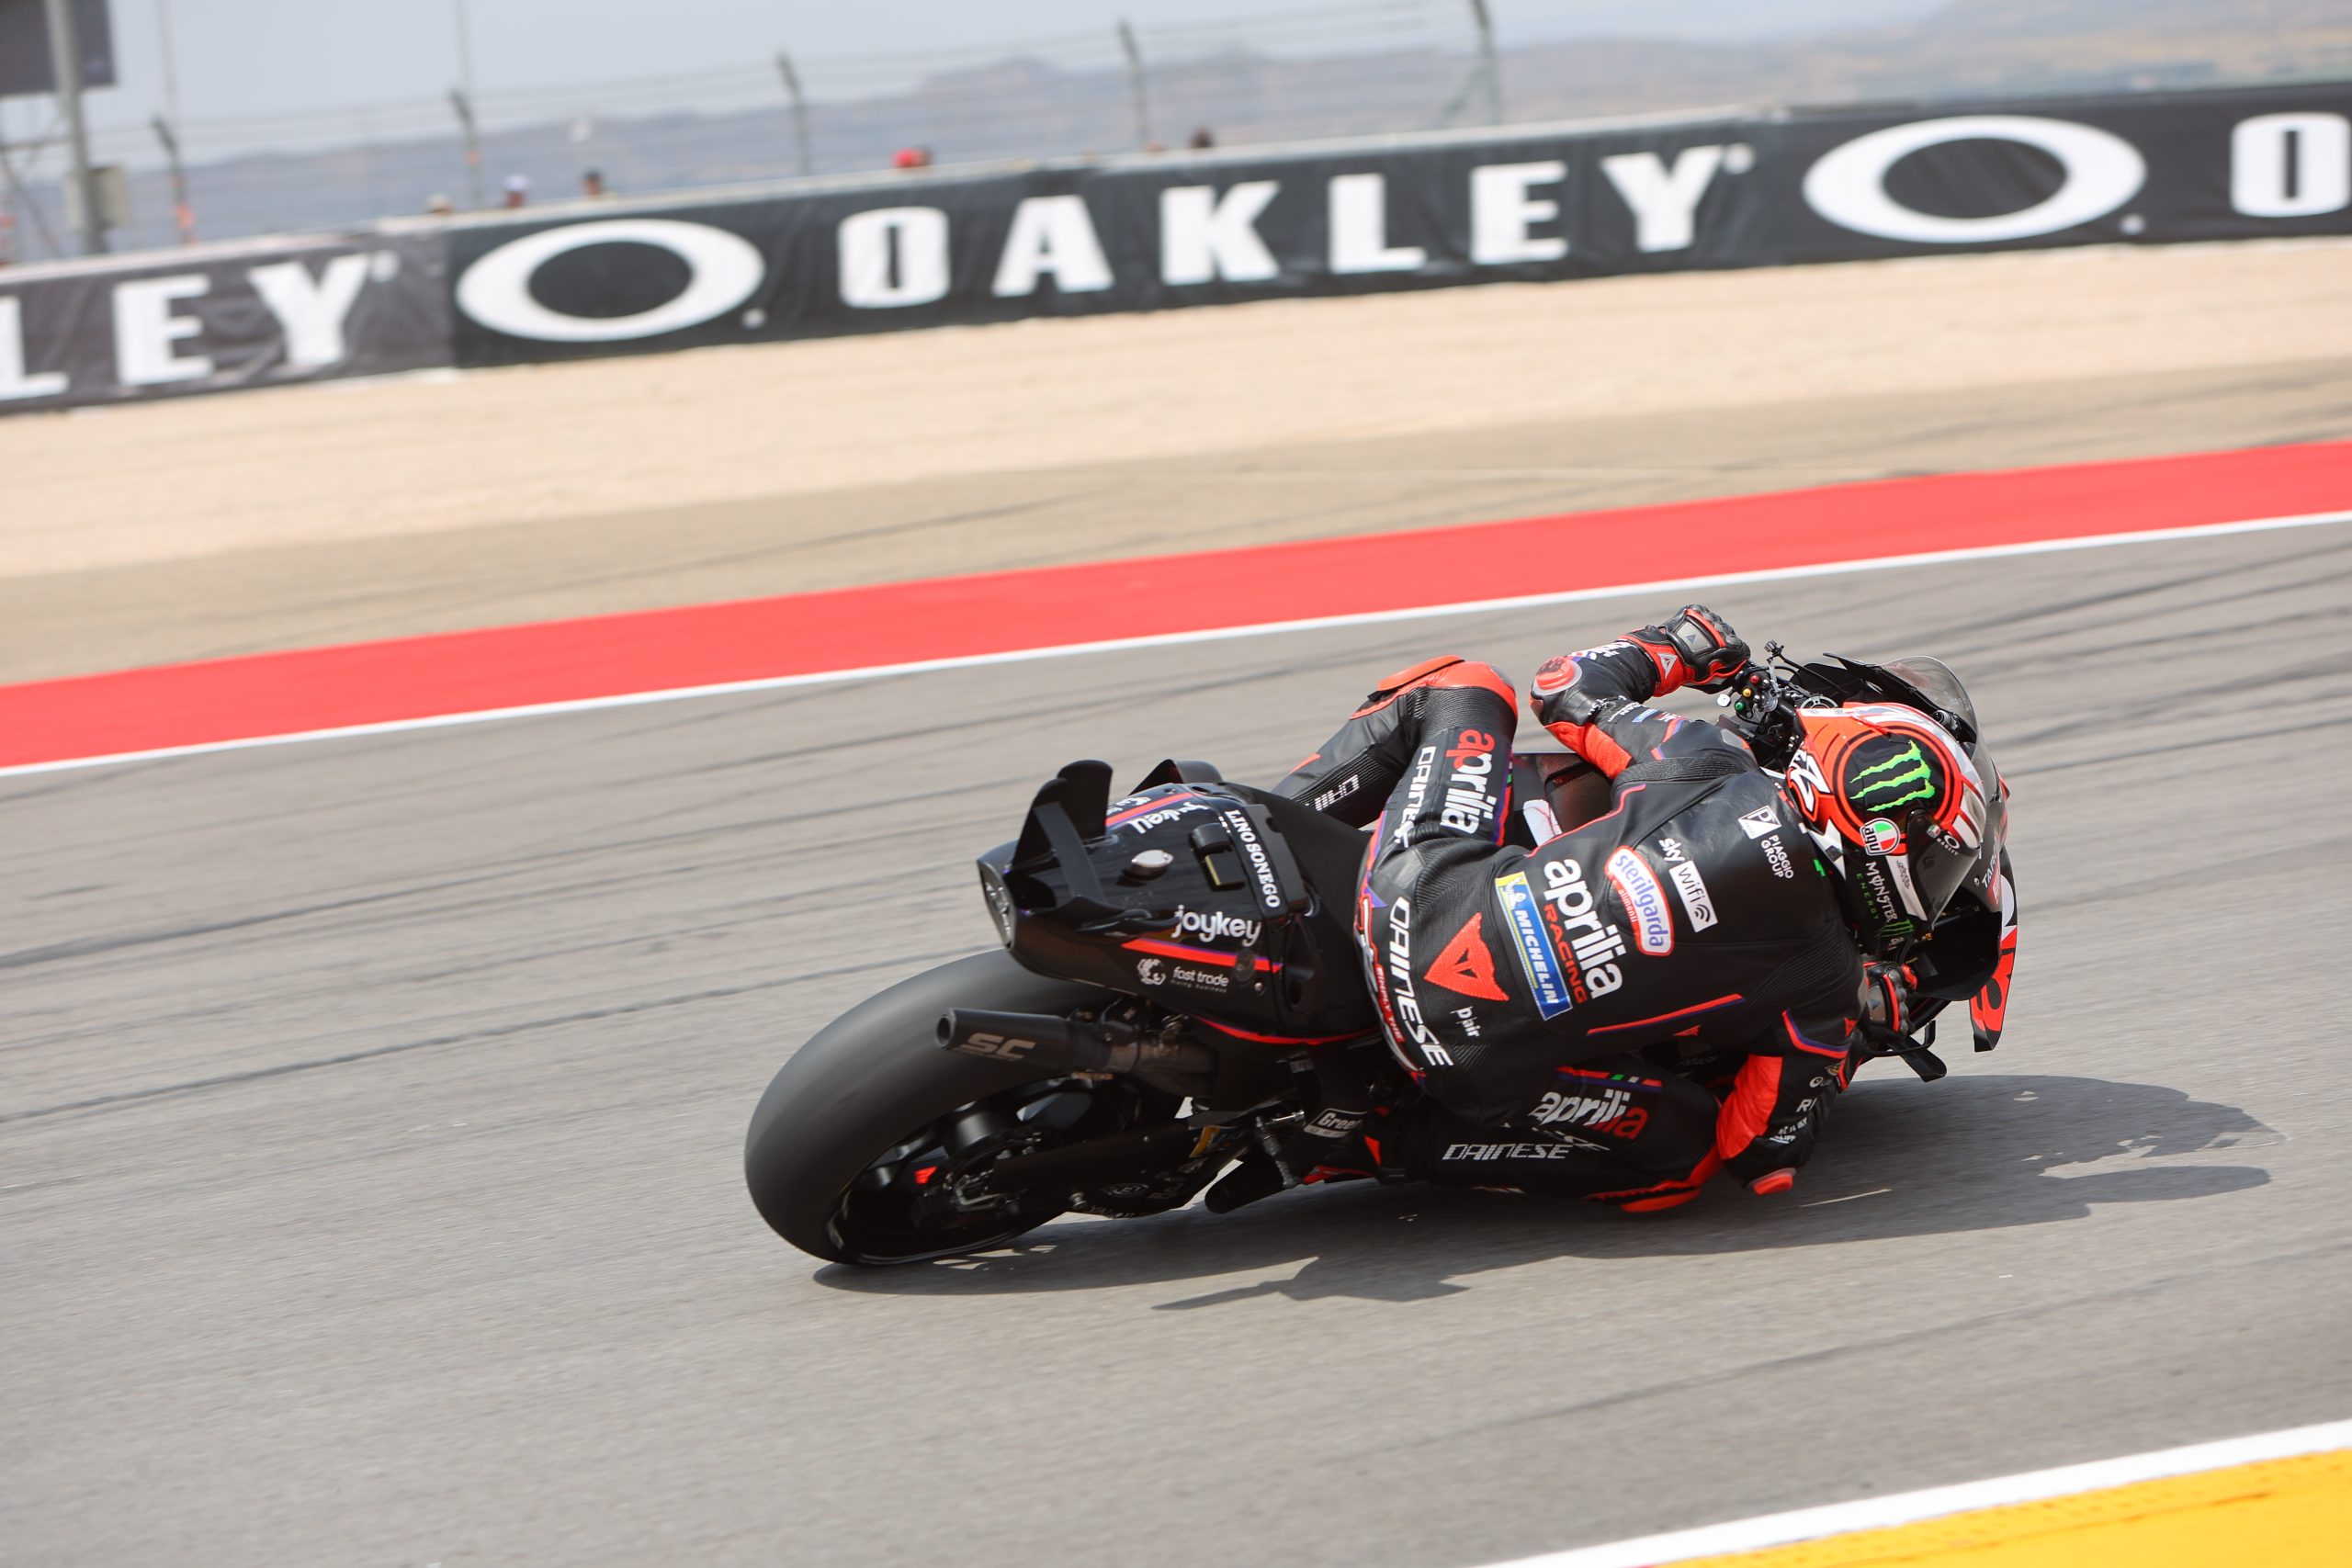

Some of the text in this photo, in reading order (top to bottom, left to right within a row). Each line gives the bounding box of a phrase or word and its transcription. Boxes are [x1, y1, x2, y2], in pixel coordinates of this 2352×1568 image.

[838, 144, 1725, 310] OAKLEY
[0, 253, 369, 400] LEY
[1440, 728, 1498, 834] aprilia
[1225, 809, 1281, 908] LINO SONEGO
[1658, 838, 1706, 904] sky wifi
[1760, 840, 1784, 878] GROUP
[1769, 834, 1794, 879] PIAGGIO
[1864, 827, 1882, 854] agv
[1615, 854, 1669, 947] sterilgarda
[1618, 888, 1639, 923] alimenti
[1865, 861, 1898, 923] MONSTER
[1170, 904, 1262, 948] joykey
[1513, 909, 1560, 1004] MICHELIN
[1544, 859, 1627, 999] aprilia
[1544, 903, 1588, 1004] RACING
[1172, 965, 1196, 982] fast
[1196, 969, 1230, 987] trade
[1389, 896, 1454, 1066] DAINESE
[1527, 1089, 1649, 1140] aprilia
[1442, 1143, 1574, 1161] DAINESE
